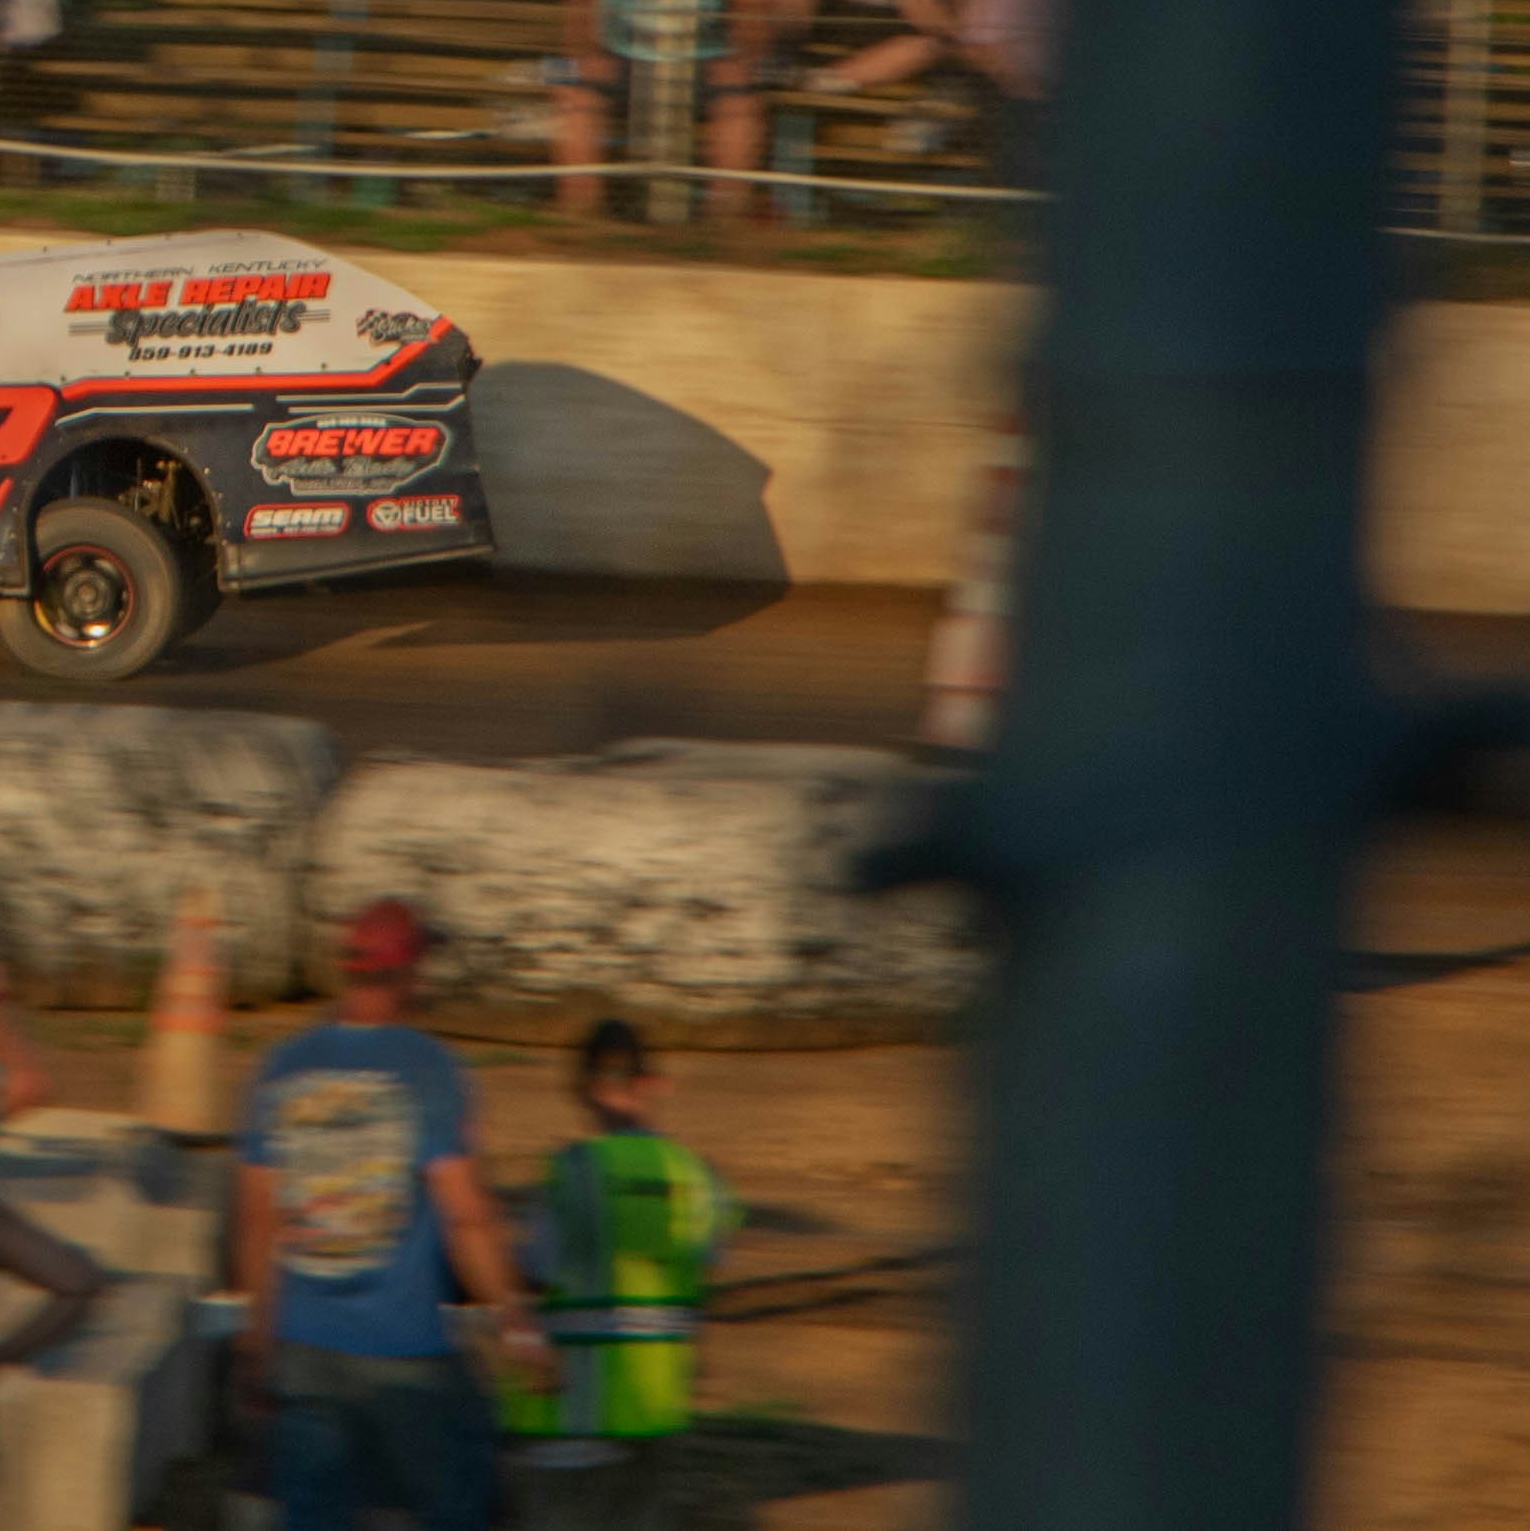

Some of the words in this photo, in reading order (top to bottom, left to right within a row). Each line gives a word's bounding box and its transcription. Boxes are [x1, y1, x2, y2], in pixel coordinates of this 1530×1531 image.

[207, 259, 327, 274] KENTUCKY
[65, 281, 173, 312] AXLE
[178, 272, 332, 306] REPAIR
[105, 300, 307, 346] Specialists
[267, 428, 438, 457] BREWER
[403, 504, 459, 525] FUEL
